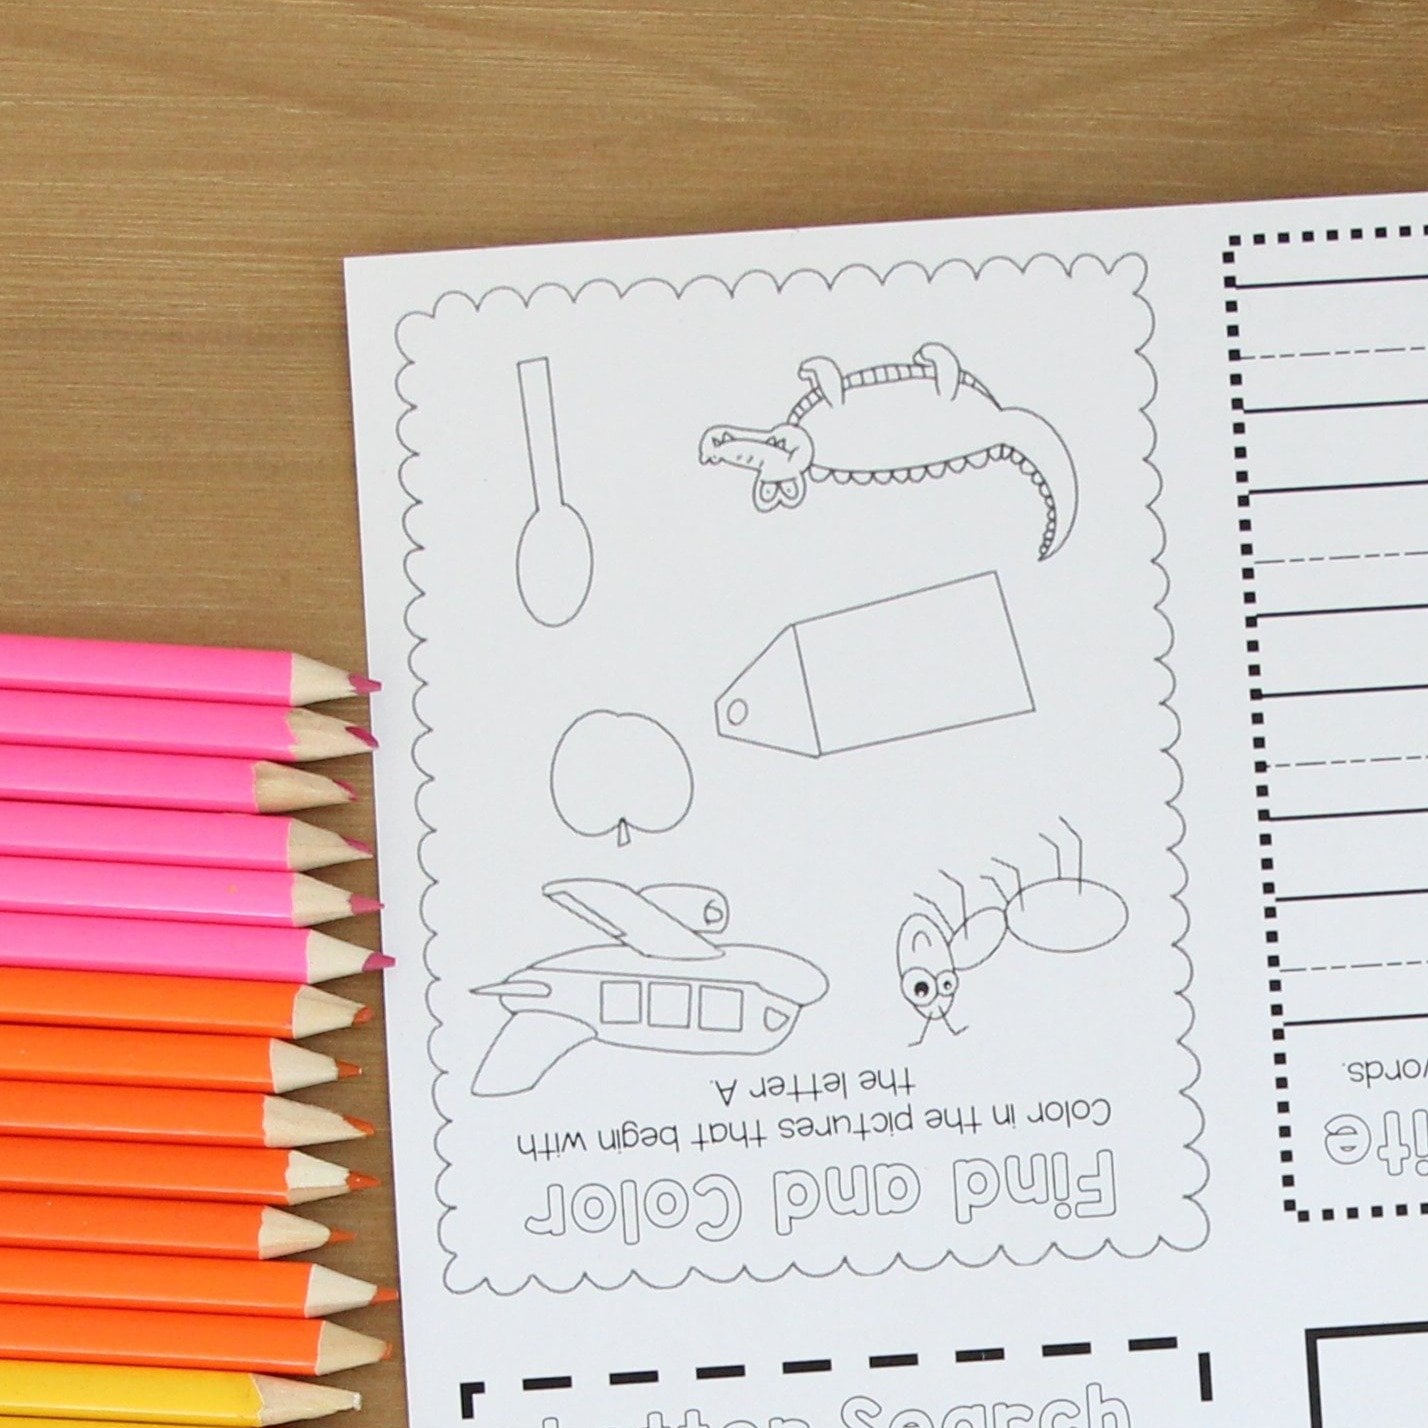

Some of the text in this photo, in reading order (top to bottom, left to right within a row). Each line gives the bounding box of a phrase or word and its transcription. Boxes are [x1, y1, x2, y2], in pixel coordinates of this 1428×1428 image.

[709, 1066, 917, 1108] the letter A.
[516, 1098, 1112, 1162] Color in the pictures that begin with
[523, 1148, 1118, 1247] Find and Color
